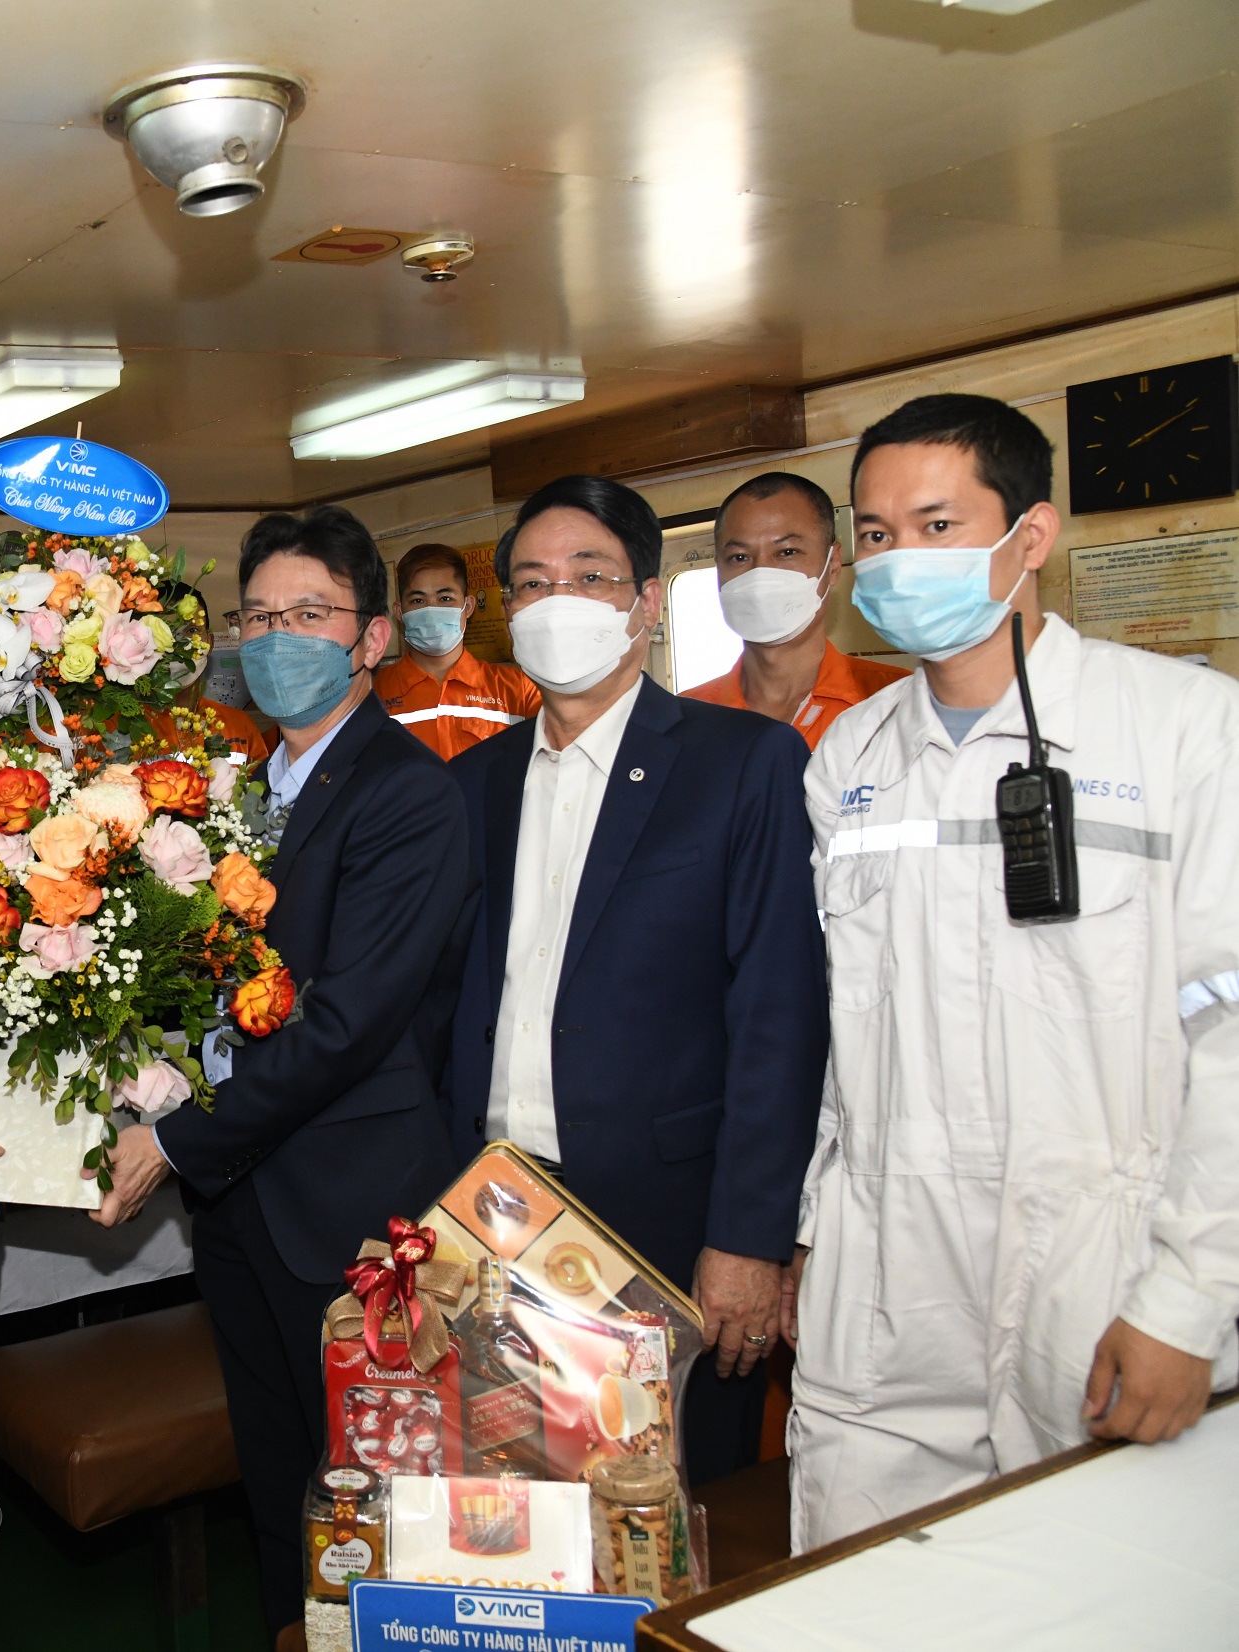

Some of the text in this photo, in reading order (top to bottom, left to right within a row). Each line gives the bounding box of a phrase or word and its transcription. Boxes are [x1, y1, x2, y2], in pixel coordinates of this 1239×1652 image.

[56, 460, 97, 478] VIMC
[50, 477, 62, 488] TY
[63, 479, 91, 494] HÀNG
[93, 484, 110, 498] HẢI
[112, 488, 132, 502] VIỆT
[133, 493, 156, 506] NAM
[4, 486, 136, 527] Chúc Mừng Năm Mới
[468, 564, 496, 579] ARNIN
[385, 695, 403, 706] MC
[465, 694, 495, 704] VINALINES
[1071, 778, 1111, 797] INES
[471, 1411, 493, 1425] RED
[495, 1397, 532, 1417] LABEL
[478, 1601, 540, 1619] VIMC
[380, 1618, 418, 1643] TỔNG
[421, 1624, 460, 1646] CÔNG
[462, 1630, 481, 1649] TY
[484, 1630, 525, 1652] HÀNG
[527, 1631, 553, 1652] HẢI
[592, 1640, 627, 1652] NAM
